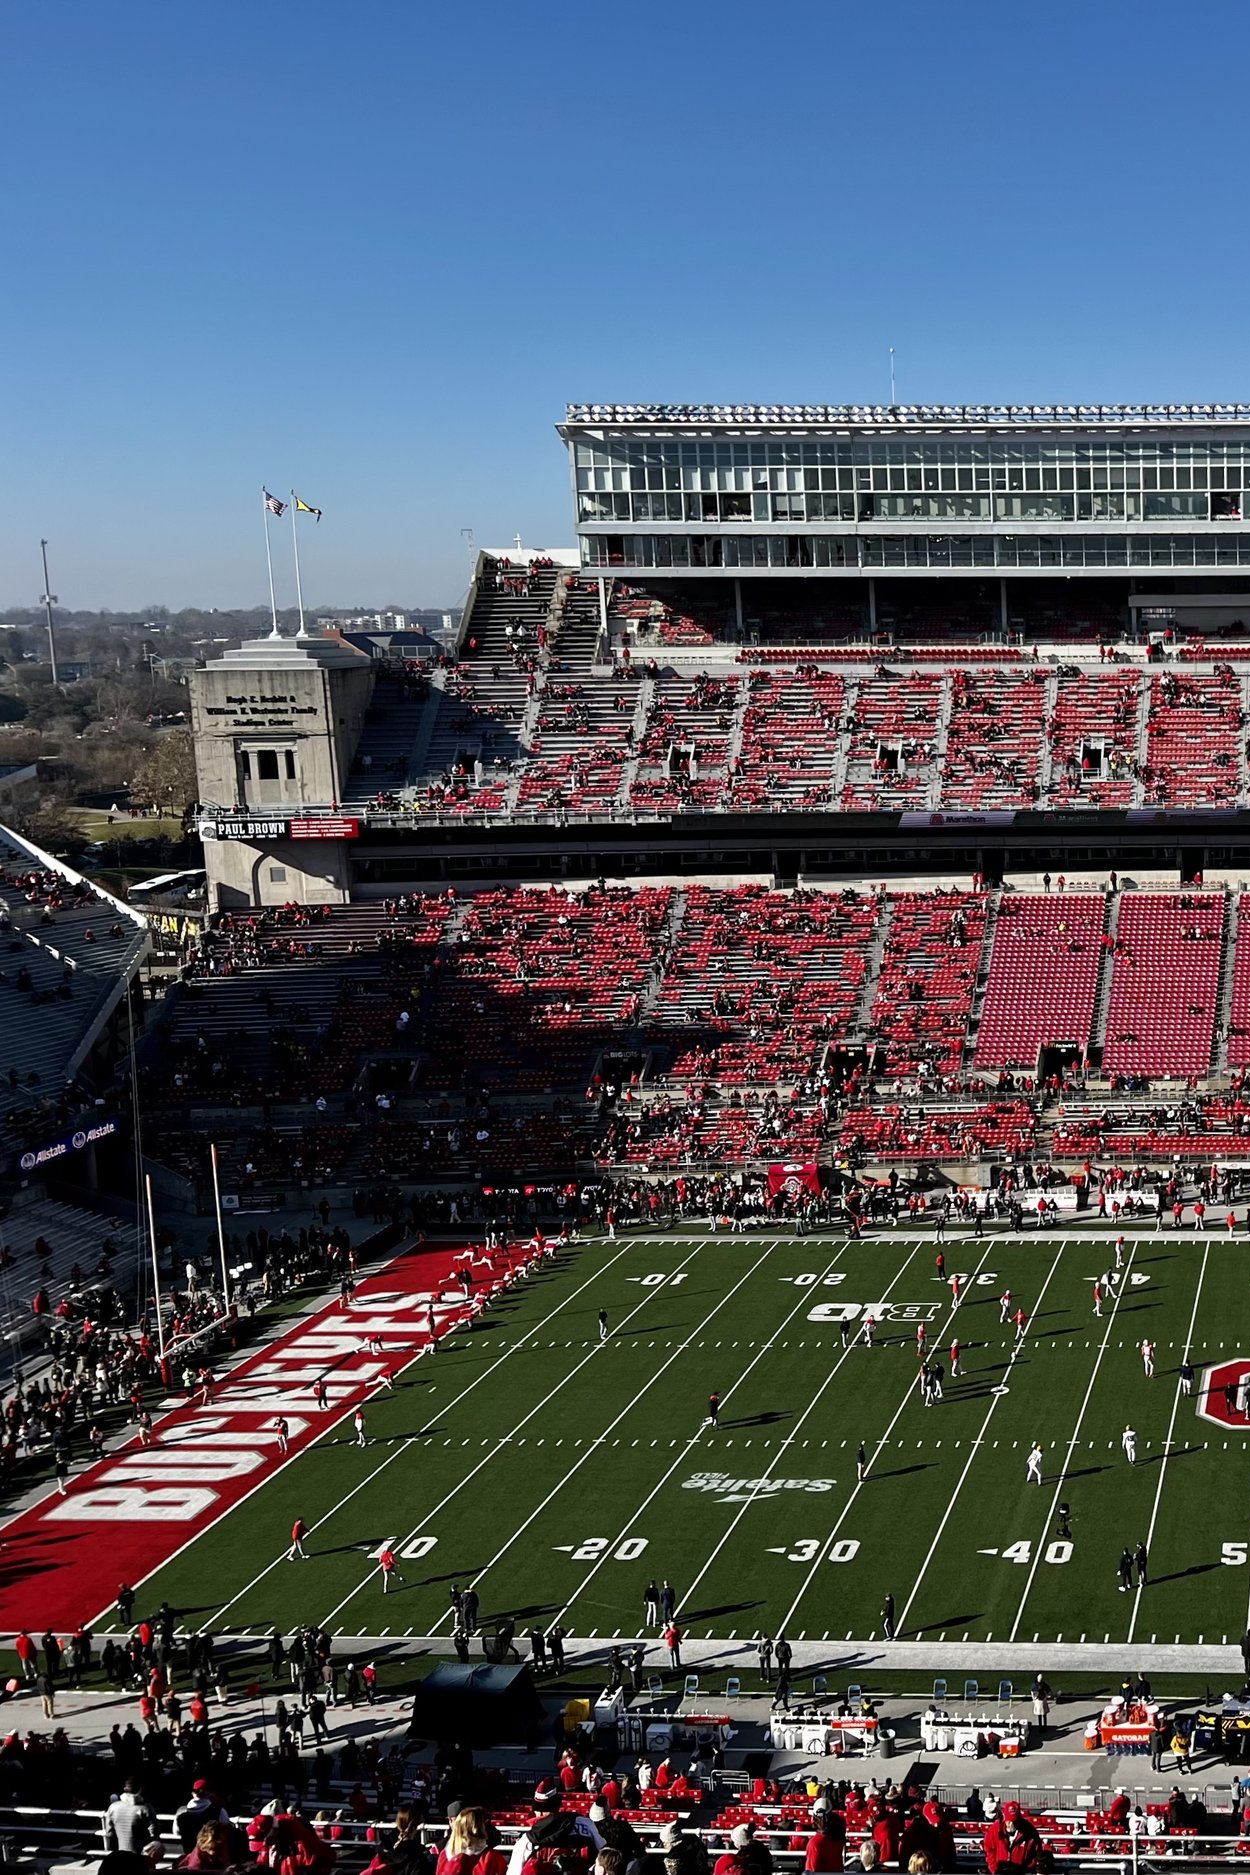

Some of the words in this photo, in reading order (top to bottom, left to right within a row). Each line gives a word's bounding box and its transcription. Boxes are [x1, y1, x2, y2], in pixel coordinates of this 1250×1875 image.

[206, 707, 238, 716] William
[290, 706, 318, 716] Family
[233, 719, 266, 727] Stadium
[267, 719, 294, 727] Center
[946, 814, 986, 824] Marathon
[218, 823, 246, 835] PAUL
[248, 822, 286, 835] BROWN
[86, 1122, 116, 1142] Allstate
[36, 1143, 67, 1165] Allstate
[640, 1273, 688, 1286] 10
[788, 1273, 848, 1286] 20
[38, 1290, 467, 1521] BUCKEYES
[681, 1478, 838, 1492] Safelite
[366, 1536, 439, 1560] 10
[570, 1537, 650, 1561] 20
[786, 1539, 861, 1562] 30
[1001, 1540, 1075, 1564] 40
[1134, 1820, 1142, 1831] 7
